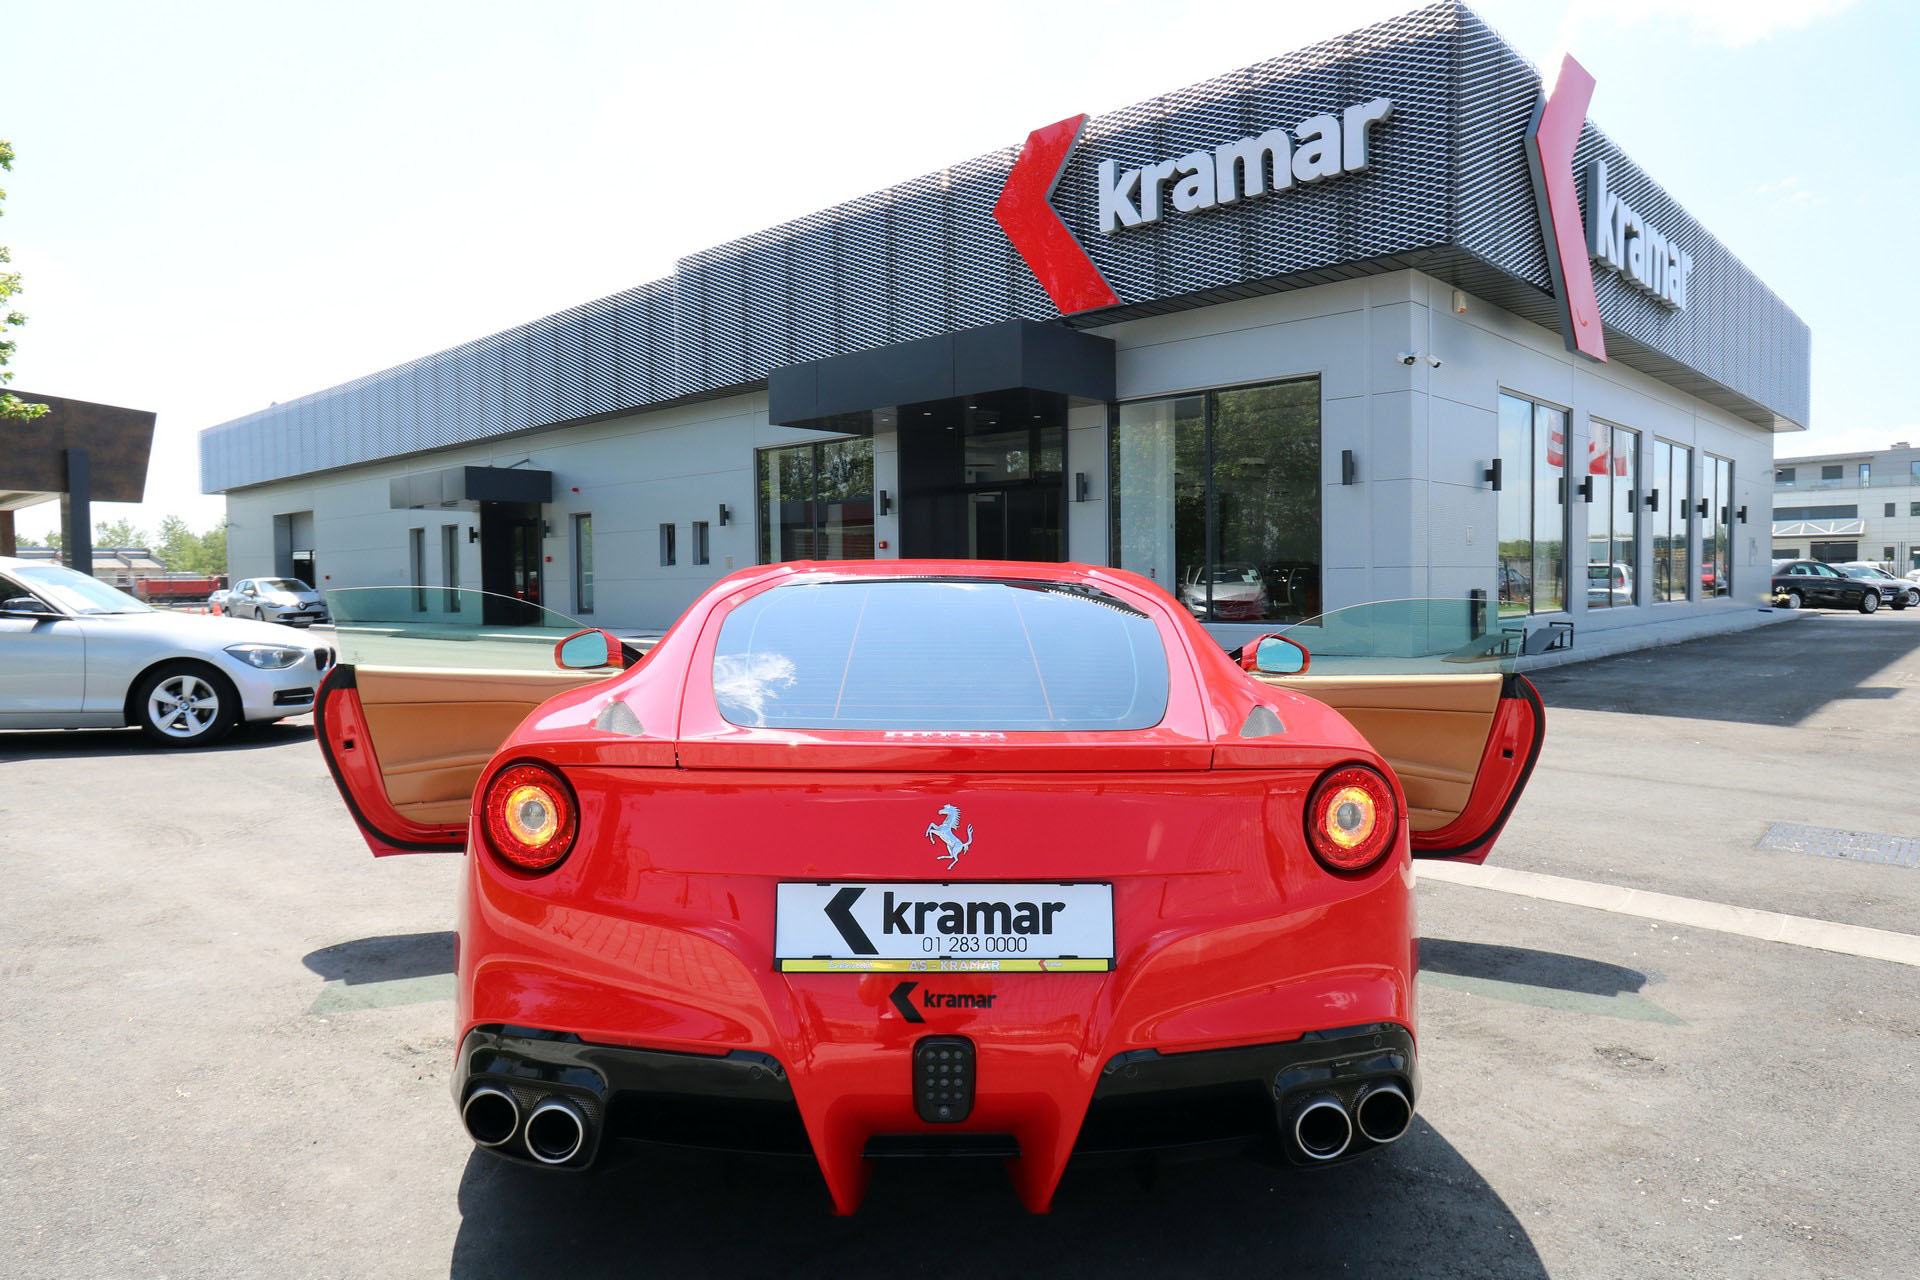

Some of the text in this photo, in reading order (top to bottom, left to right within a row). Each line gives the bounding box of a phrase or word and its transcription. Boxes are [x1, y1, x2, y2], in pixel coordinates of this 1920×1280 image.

[1098, 98, 1394, 234] kramar
[1587, 159, 1694, 312] kramar
[883, 891, 1066, 935] kramar
[922, 936, 1028, 952] 01 283 0000
[908, 959, 928, 971] AS
[939, 959, 1000, 971] KRAMAR
[923, 989, 998, 1009] kramar
